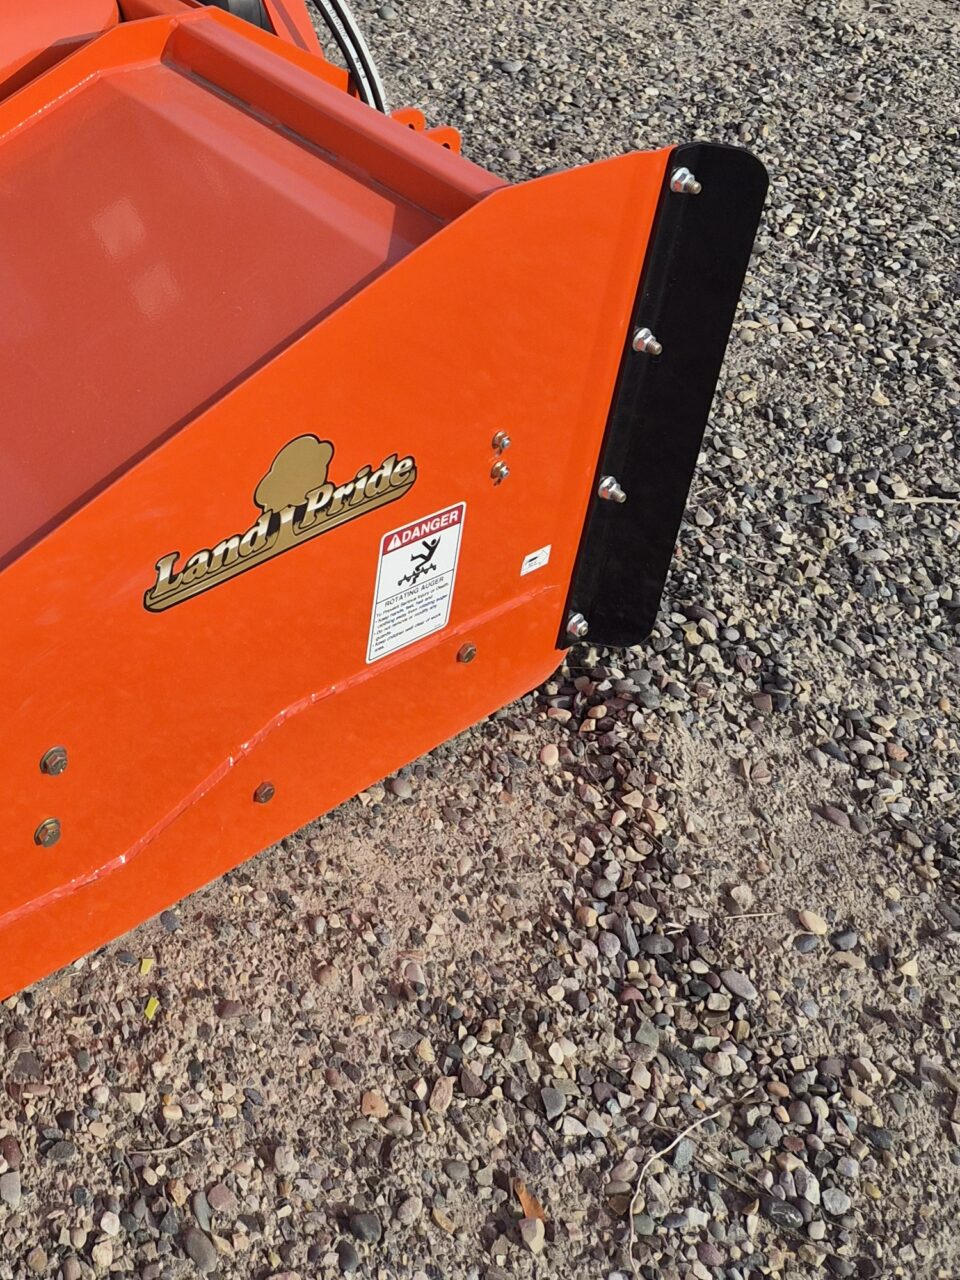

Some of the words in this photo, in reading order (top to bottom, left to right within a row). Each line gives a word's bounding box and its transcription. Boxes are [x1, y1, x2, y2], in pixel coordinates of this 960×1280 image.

[150, 509, 274, 600] Land
[297, 453, 416, 530] Pride
[402, 510, 459, 544] DANGER
[384, 588, 419, 607] ROTATING
[421, 576, 445, 591] AUGER
